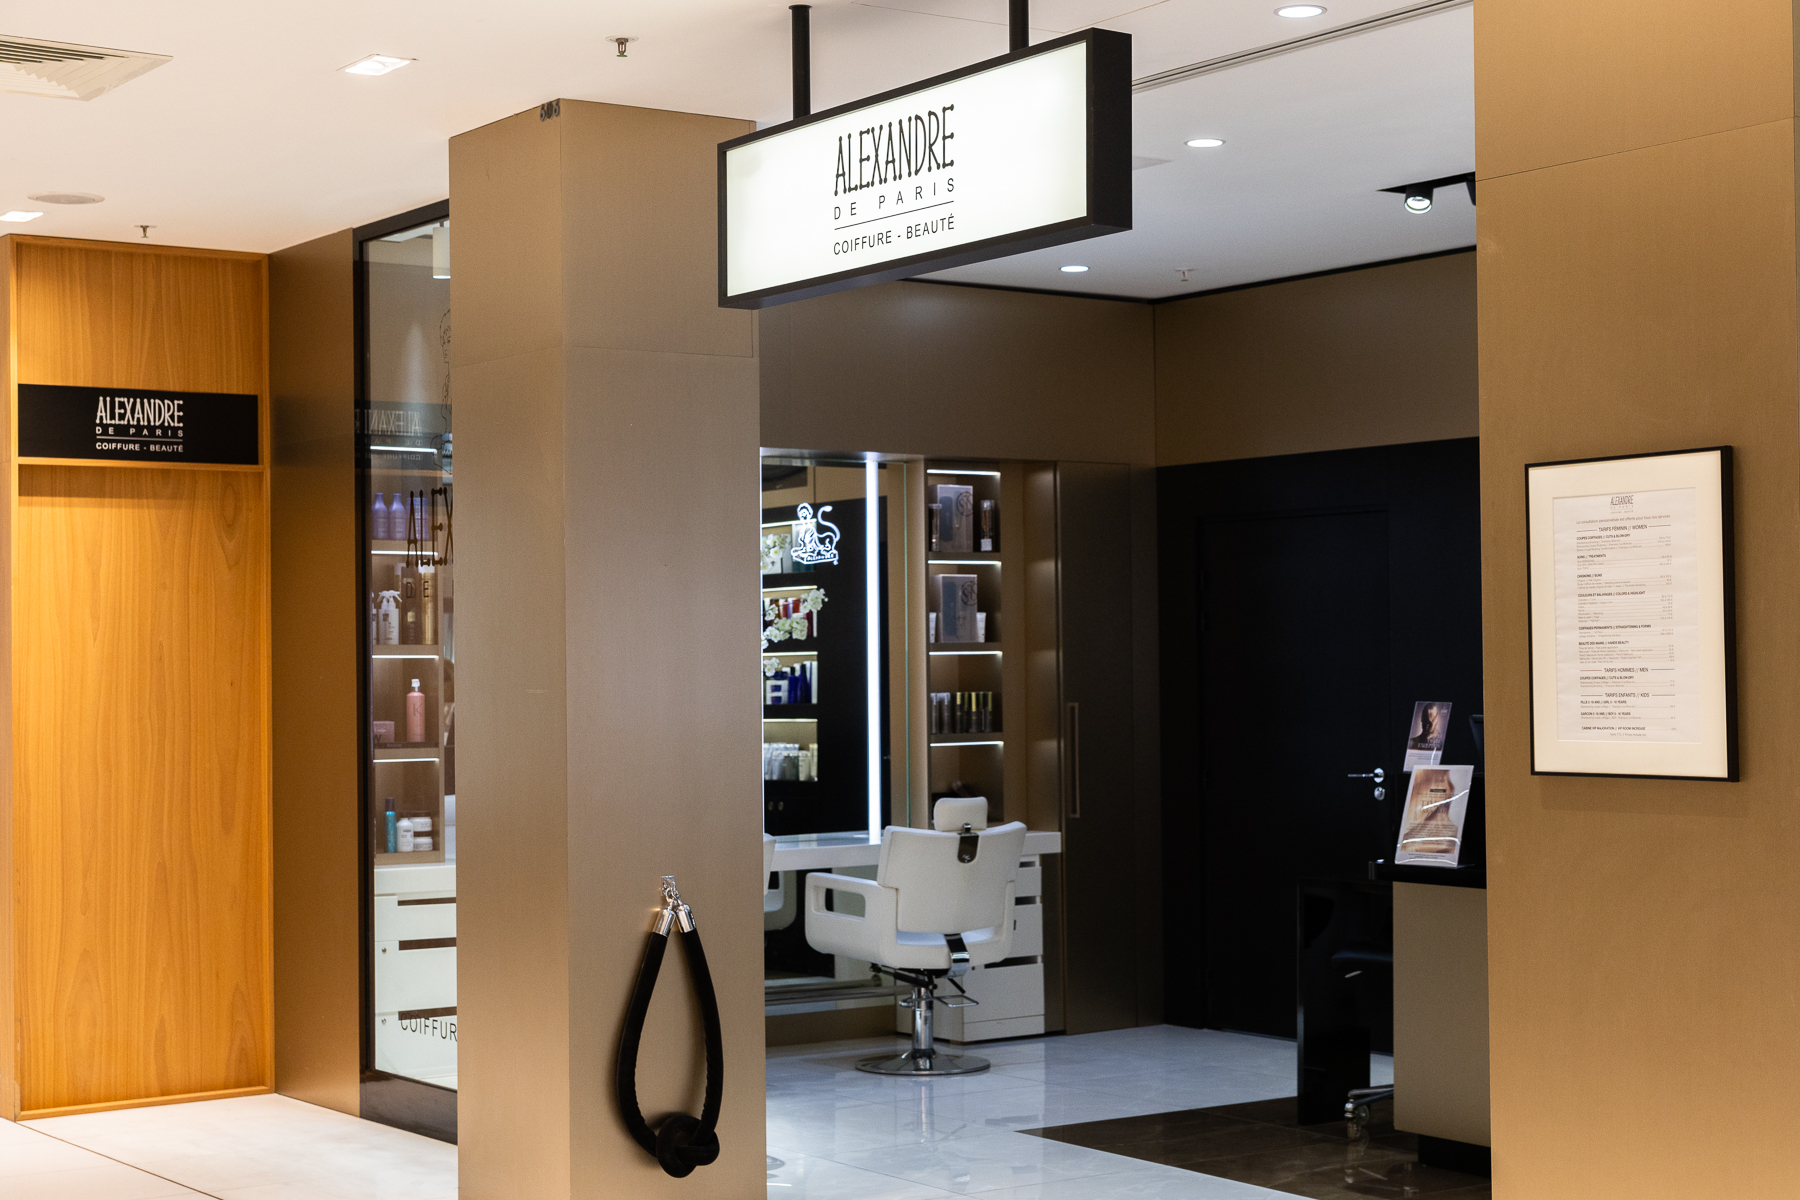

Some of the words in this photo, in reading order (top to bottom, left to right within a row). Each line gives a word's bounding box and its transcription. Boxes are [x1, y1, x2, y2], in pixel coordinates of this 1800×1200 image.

[834, 104, 954, 196] ALEXANDRE
[834, 201, 857, 220] DE
[878, 177, 955, 209] PARIS
[833, 230, 892, 256] COIFFURE
[906, 213, 955, 240] BEAUTÉ
[96, 396, 183, 427] ALEXANDRE
[96, 427, 114, 435] DE
[130, 427, 183, 437] PARIS
[96, 442, 140, 451] COIFFURE
